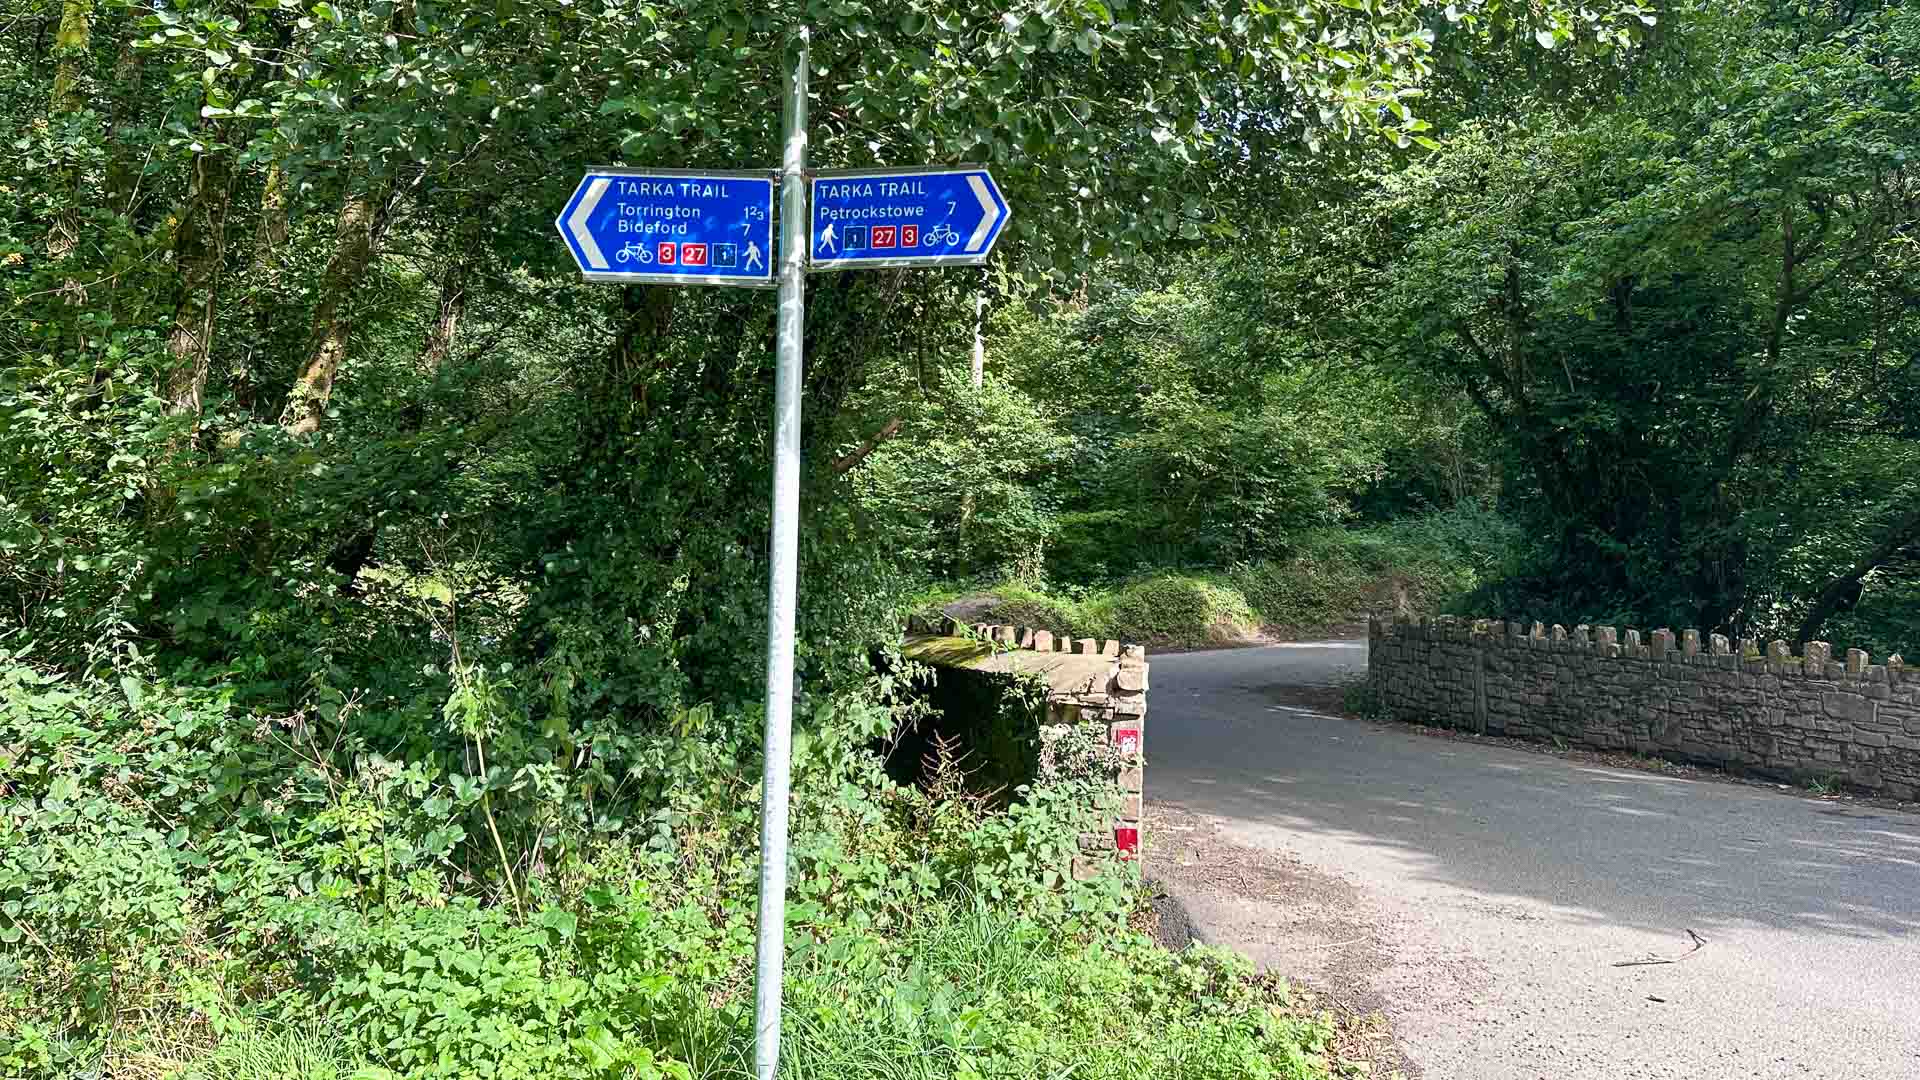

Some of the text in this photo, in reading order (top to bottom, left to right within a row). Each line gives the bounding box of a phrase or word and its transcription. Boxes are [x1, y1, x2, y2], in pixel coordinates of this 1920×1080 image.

[617, 181, 729, 198] TARKA TRAIL
[819, 181, 926, 198] TARKA TRAIL
[617, 202, 701, 219] Torrington
[820, 201, 957, 221] Petrockstowe 7
[617, 219, 751, 236] Bideford 7
[874, 231, 892, 244] 27
[904, 230, 915, 243] 3
[662, 248, 672, 260] 3
[685, 248, 704, 261] 27
